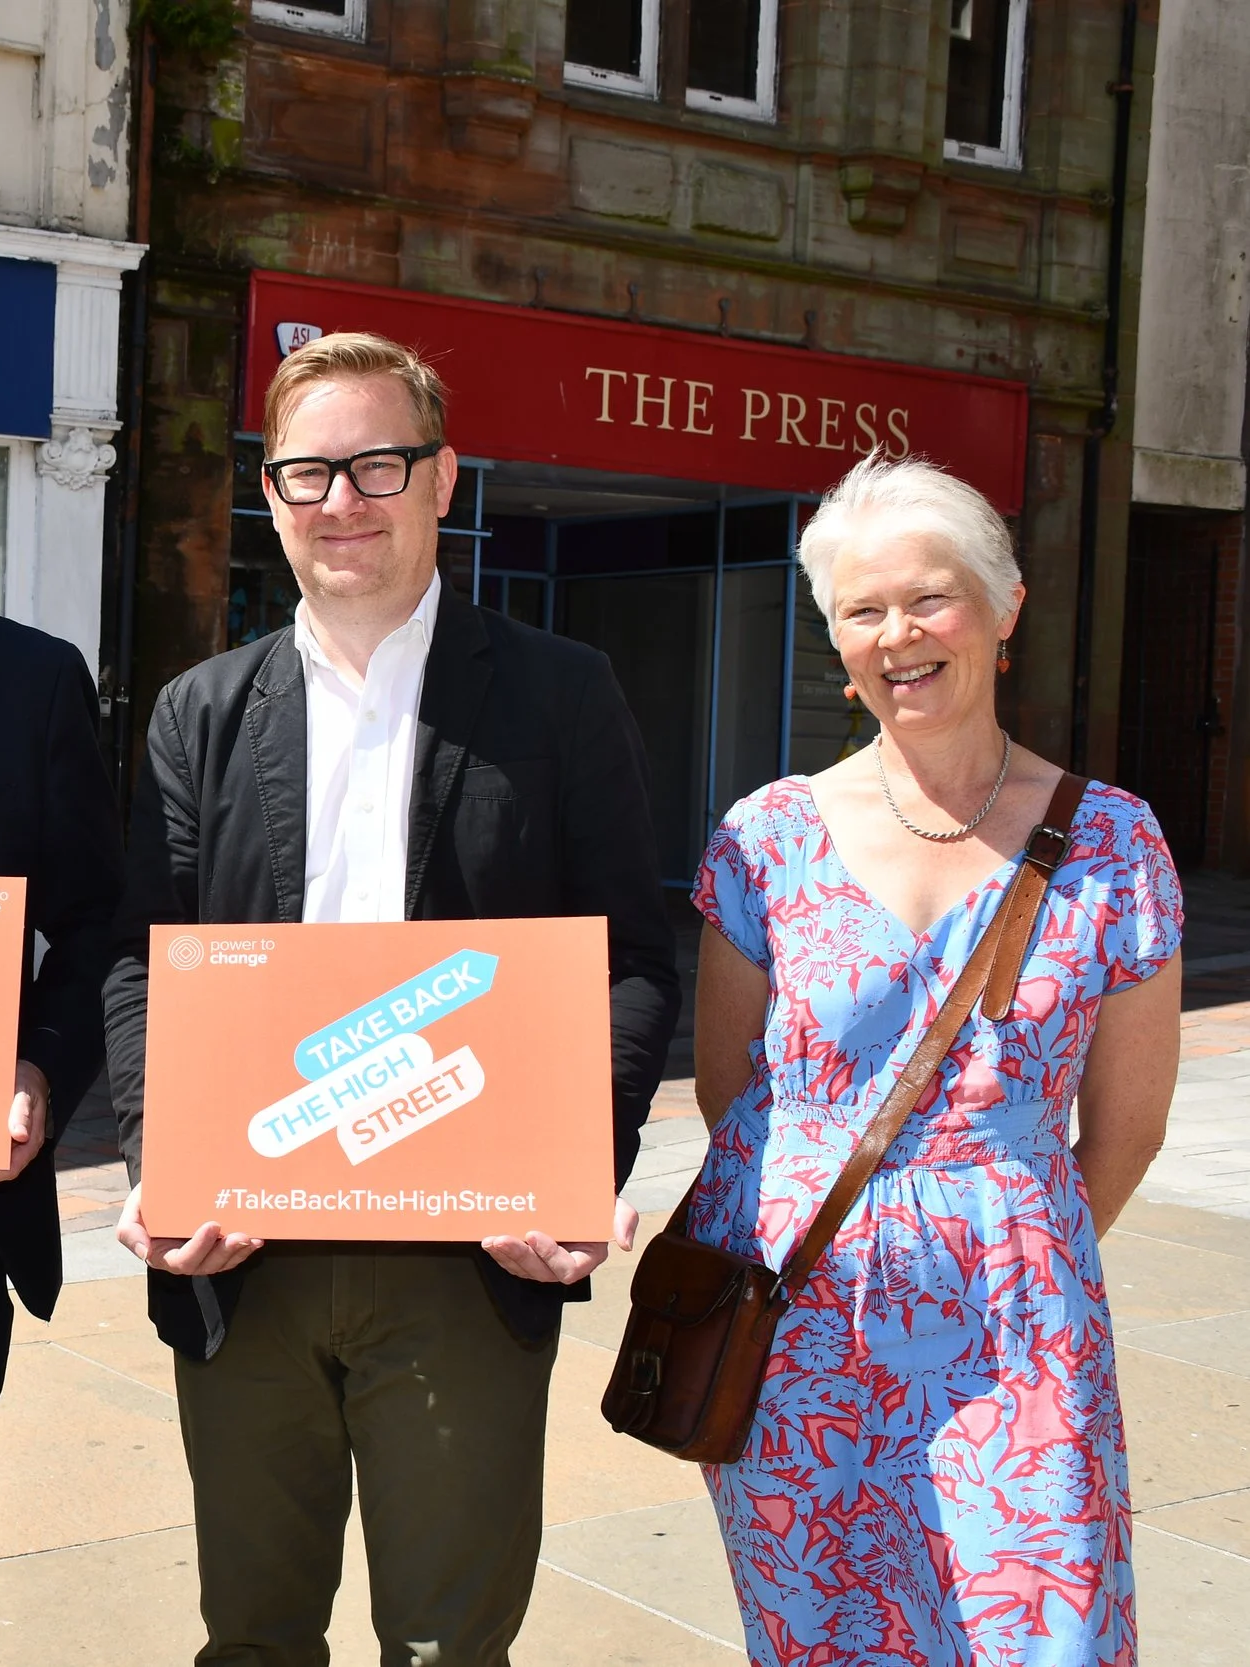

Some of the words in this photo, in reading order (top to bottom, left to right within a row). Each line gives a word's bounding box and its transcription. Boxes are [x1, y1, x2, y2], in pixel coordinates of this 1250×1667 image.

[585, 367, 714, 435] THE
[739, 388, 910, 460] PRESS
[209, 952, 268, 967] change
[210, 940, 257, 953] power
[261, 938, 276, 951] to
[306, 1010, 393, 1070] TAKE
[389, 960, 483, 1026] BACK
[261, 1094, 330, 1144] THE
[329, 1047, 415, 1109] HIGH
[351, 1064, 468, 1145] STREET
[214, 1188, 537, 1217] #TakeBackTheHighStreet
